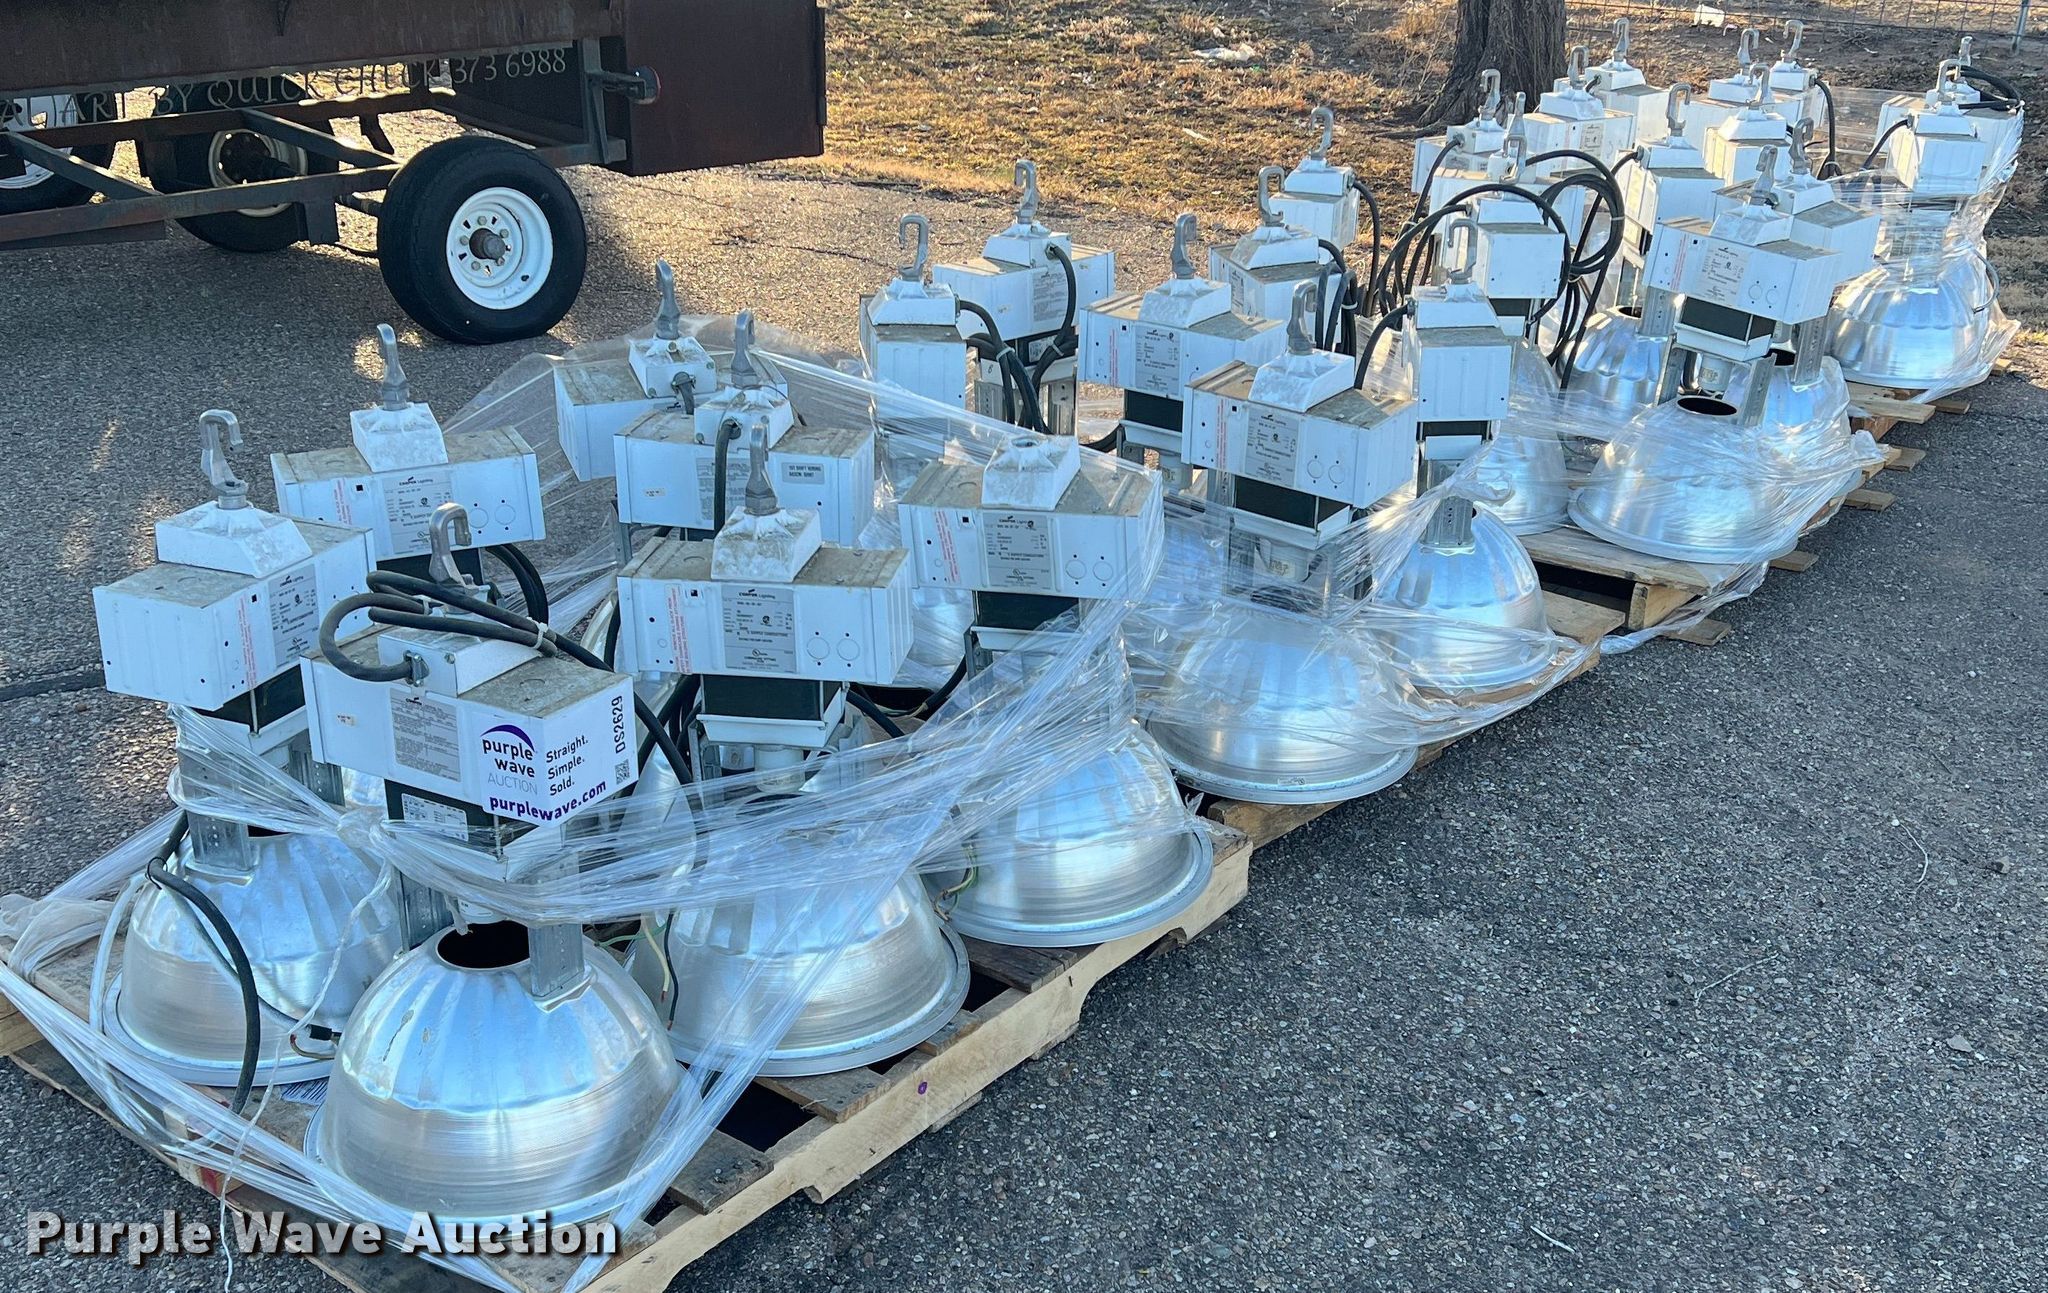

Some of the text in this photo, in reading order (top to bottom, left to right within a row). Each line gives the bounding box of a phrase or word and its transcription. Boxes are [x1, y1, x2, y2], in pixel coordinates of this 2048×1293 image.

[149, 82, 195, 115] BY
[207, 70, 327, 111] QUICK
[453, 53, 498, 84] 373
[505, 48, 566, 78] 6988
[611, 695, 626, 754] DS2629
[482, 738, 533, 761] purple
[546, 734, 589, 763] Straight.
[494, 757, 535, 778] wave
[547, 755, 585, 780] Simple.
[487, 772, 538, 796] AUCTION
[549, 776, 575, 796] Sold.
[489, 780, 607, 821] purplewave.com
